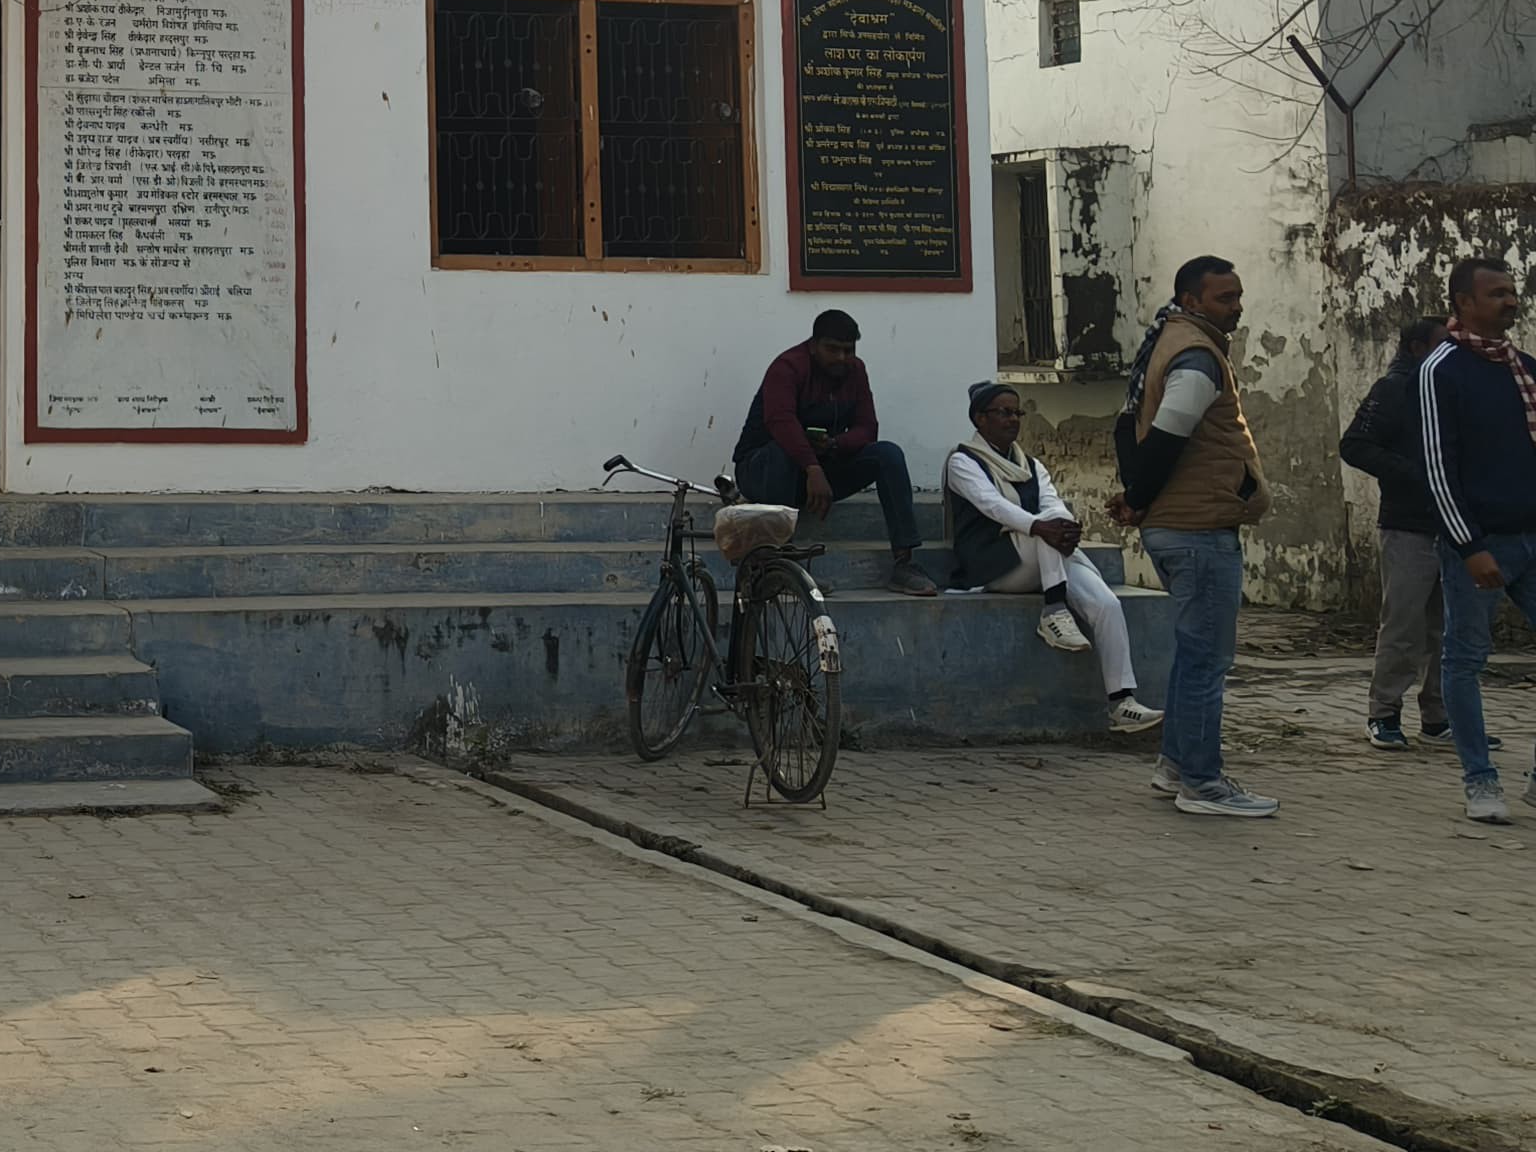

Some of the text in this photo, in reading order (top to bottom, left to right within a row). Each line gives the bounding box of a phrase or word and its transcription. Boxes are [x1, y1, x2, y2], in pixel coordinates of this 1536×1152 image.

[824, 47, 844, 60] लाश
[848, 48, 861, 60] घर
[866, 49, 879, 61] का
[91, 256, 116, 267] विभाग
[183, 256, 191, 267] से
[64, 271, 84, 280] अन्य
